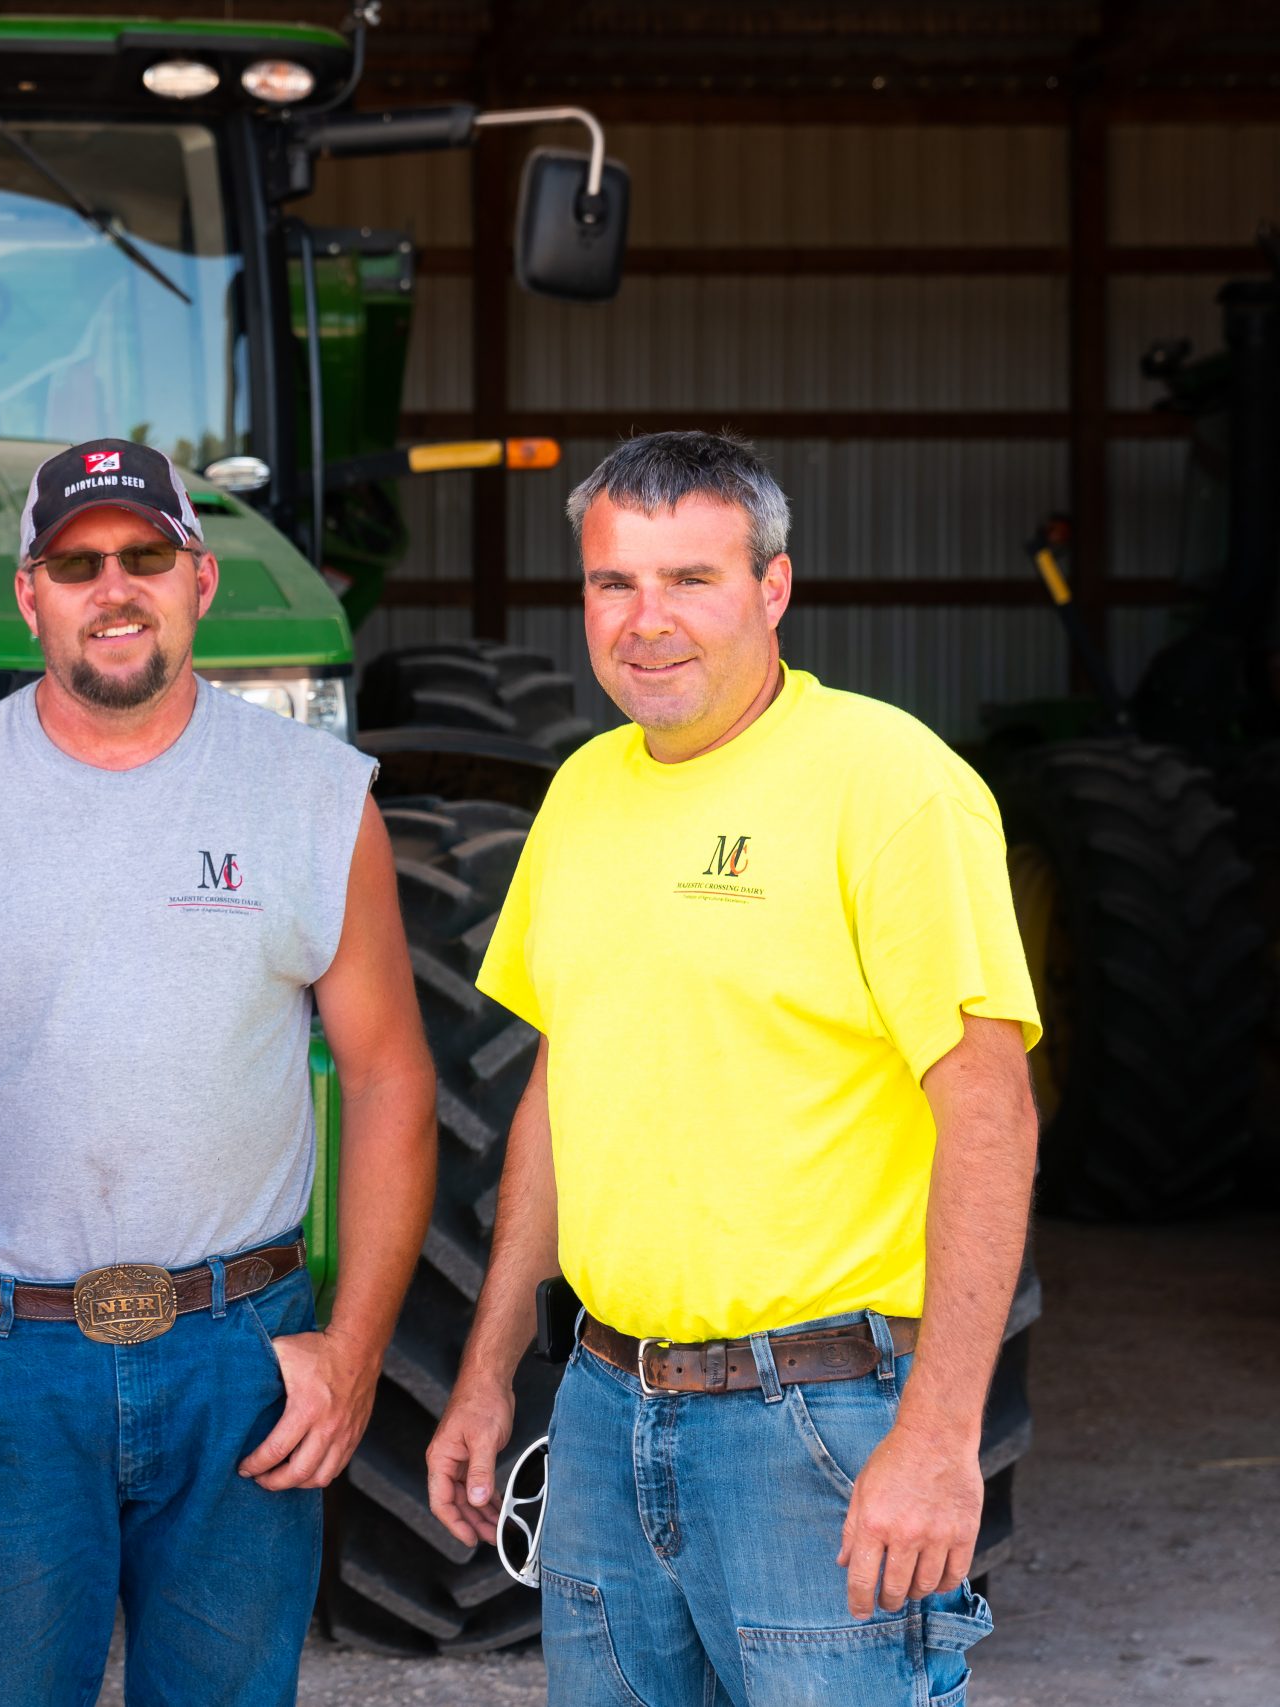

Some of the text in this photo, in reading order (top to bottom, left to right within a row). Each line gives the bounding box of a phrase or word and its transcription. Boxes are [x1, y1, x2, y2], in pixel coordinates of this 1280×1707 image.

[64, 475, 145, 498] DAIRYLAND SEED
[704, 882, 739, 892] CROSSING
[740, 886, 764, 895] DAIRY
[169, 895, 205, 903] MAJESTIC
[205, 896, 240, 904] CROSSING
